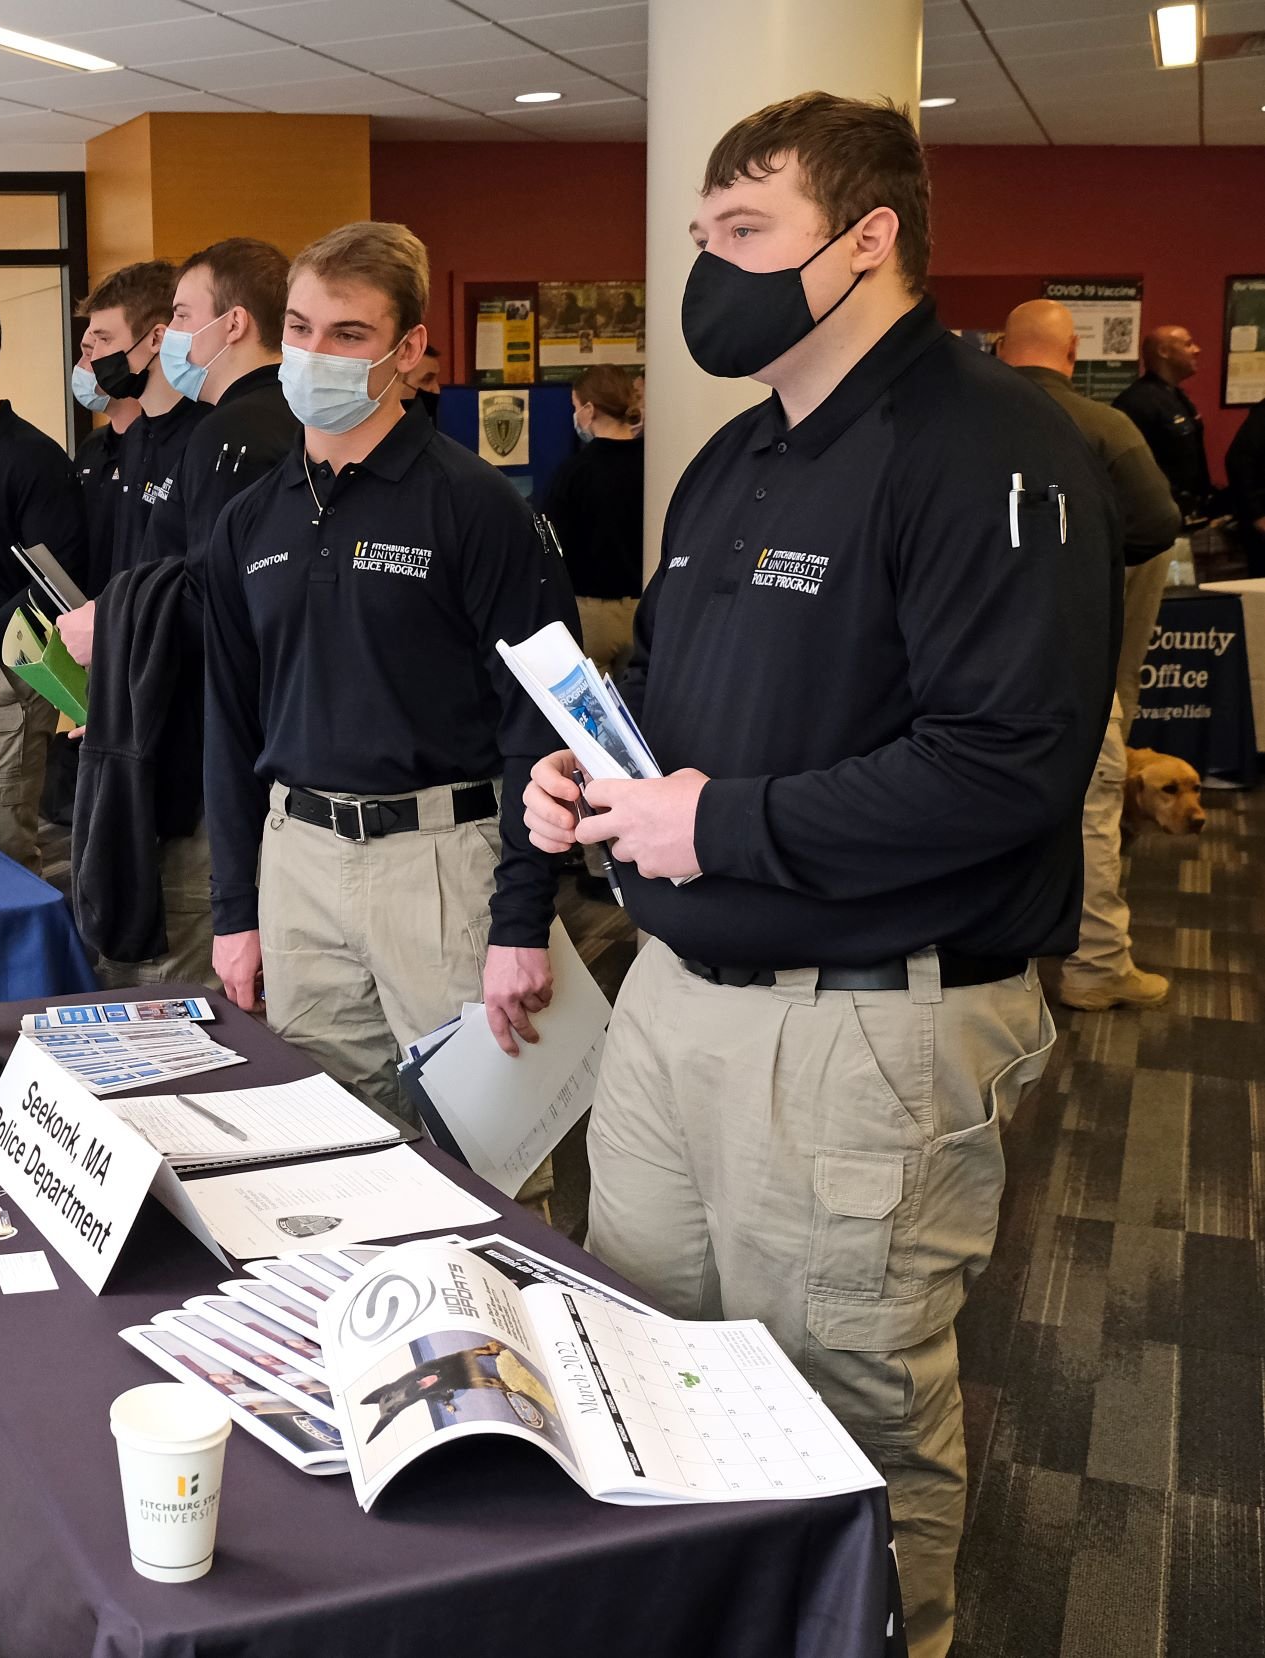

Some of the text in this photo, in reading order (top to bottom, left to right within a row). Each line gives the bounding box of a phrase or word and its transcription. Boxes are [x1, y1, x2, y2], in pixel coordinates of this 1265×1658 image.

[1097, 286, 1137, 297] Vaccine
[369, 550, 431, 567] UNIVERSITY
[371, 543, 432, 558] FITCHBURG STATE
[773, 550, 829, 566] FITCHBURG STATE
[246, 551, 289, 575] LUCONTONI
[352, 560, 427, 579] POLICE PROGRAM
[768, 559, 827, 579] UNIVERSITY
[751, 573, 821, 596] POLICE PROGRAM
[1147, 625, 1236, 657] County
[1139, 664, 1209, 689] Office
[22, 1081, 112, 1186] Seekonk, MA
[24, 1144, 112, 1254] Department
[448, 1263, 480, 1318] SPORTS
[555, 1341, 585, 1374] 2022
[568, 1375, 602, 1416] March
[140, 1498, 200, 1512] FITCHBURG
